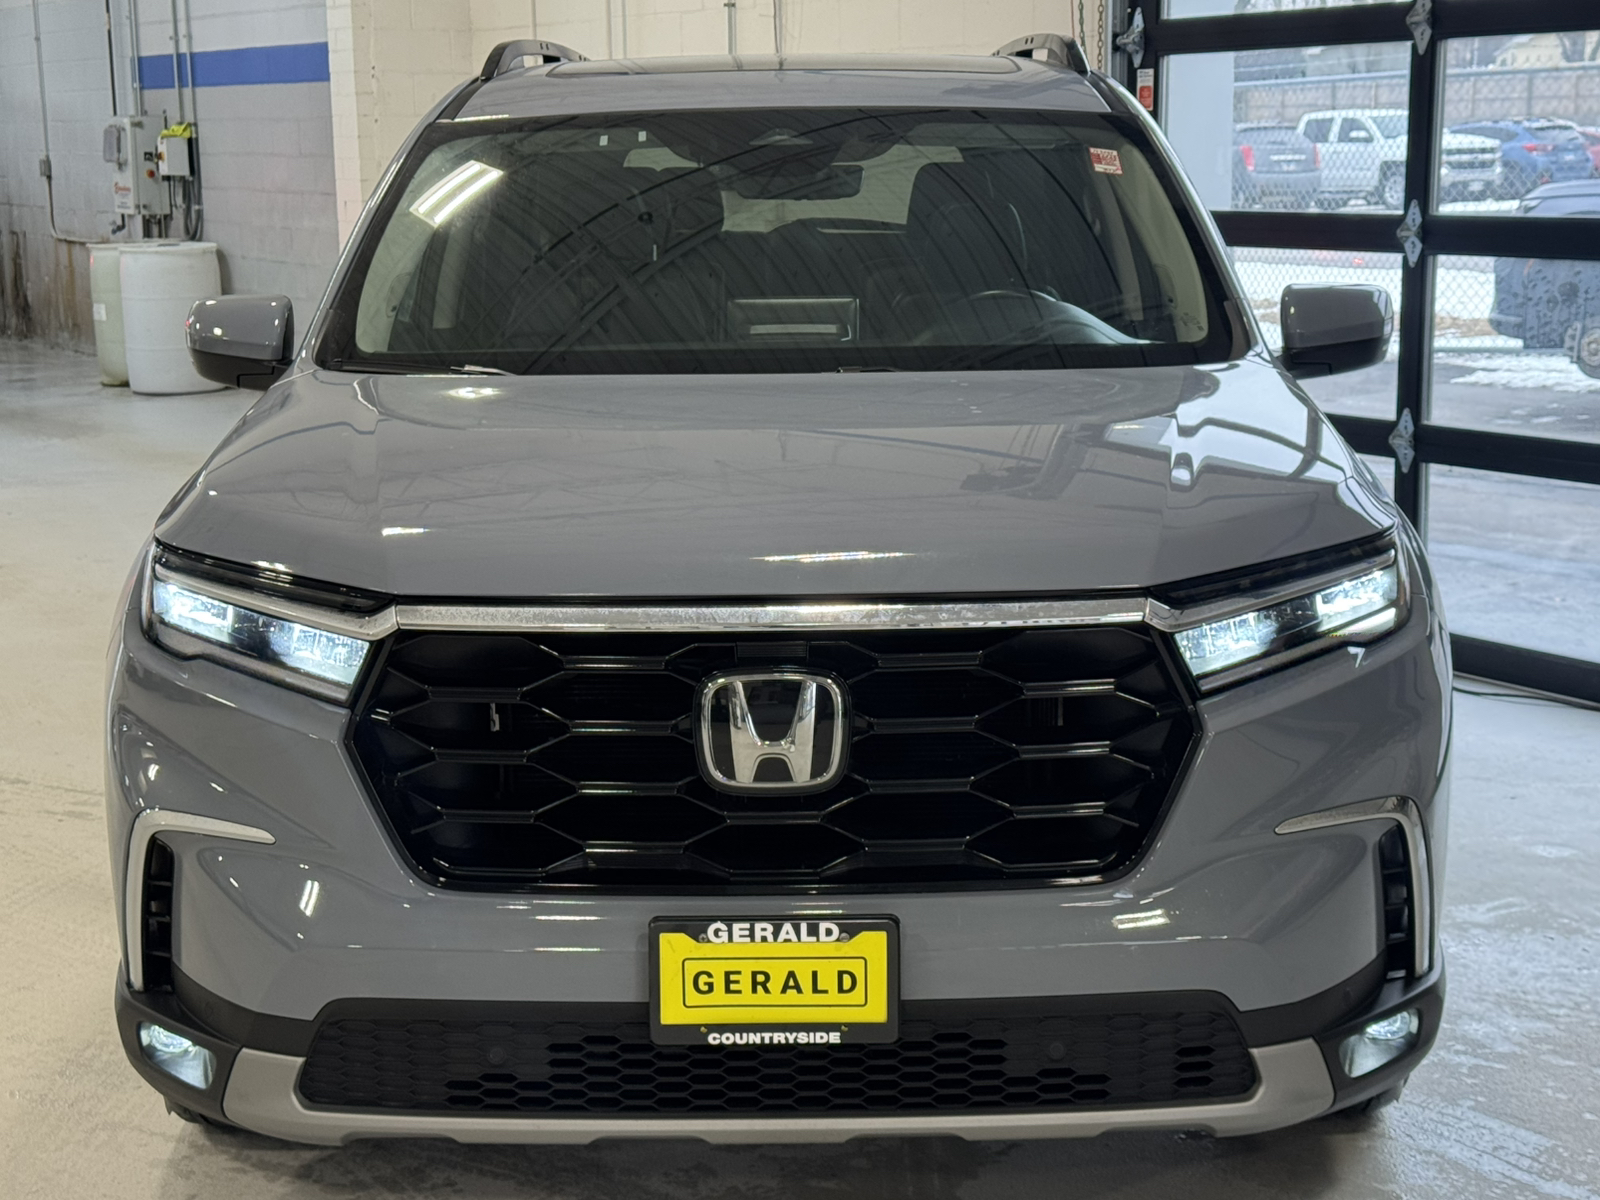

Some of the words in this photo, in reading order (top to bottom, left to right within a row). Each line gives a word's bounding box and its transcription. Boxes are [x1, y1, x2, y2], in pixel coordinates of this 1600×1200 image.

[707, 921, 840, 944] GERALD
[692, 970, 858, 995] GERALD
[707, 1032, 841, 1045] COUNTRYSIDE
